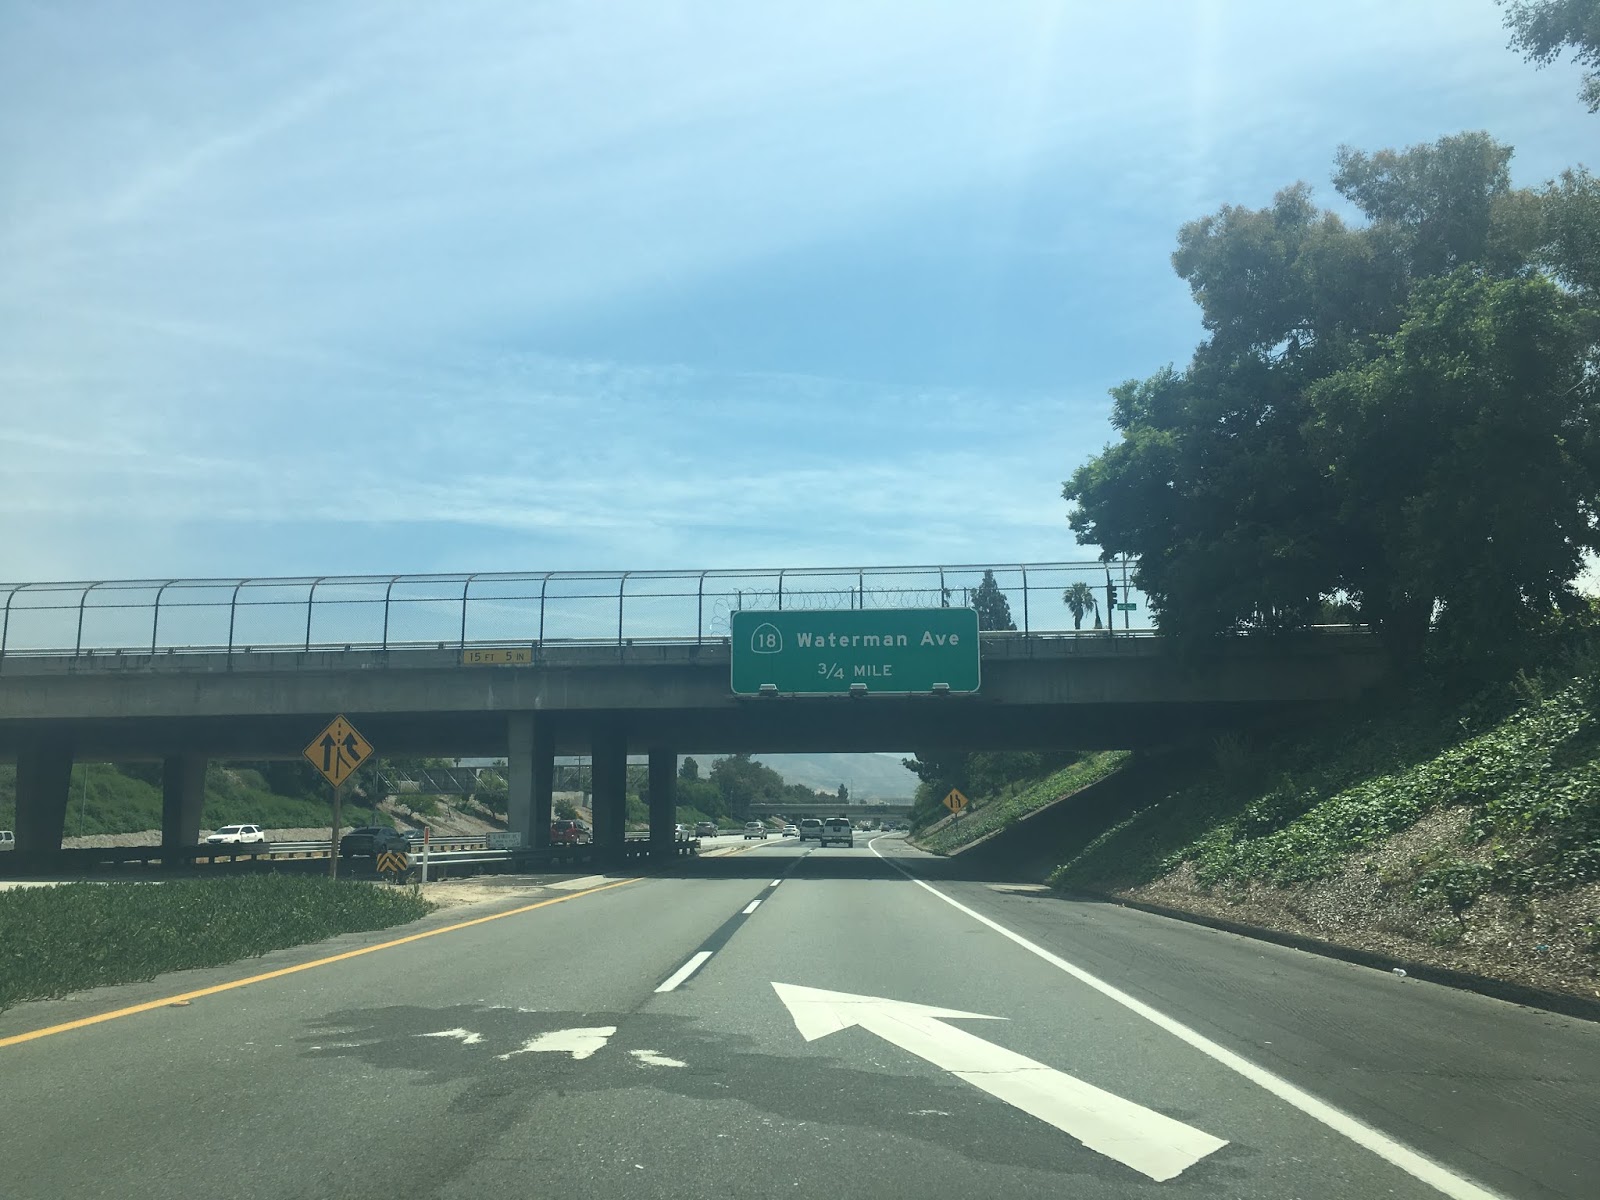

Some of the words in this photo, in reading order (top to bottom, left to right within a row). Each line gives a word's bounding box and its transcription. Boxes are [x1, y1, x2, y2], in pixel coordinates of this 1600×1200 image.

[758, 633, 777, 648] 18
[796, 632, 908, 648] Waterman
[920, 630, 960, 646] Ave
[469, 652, 481, 662] 15
[484, 653, 495, 662] FT
[505, 651, 513, 661] 5
[516, 653, 525, 661] IN
[817, 662, 845, 680] 3/4
[854, 664, 893, 677] MILE
